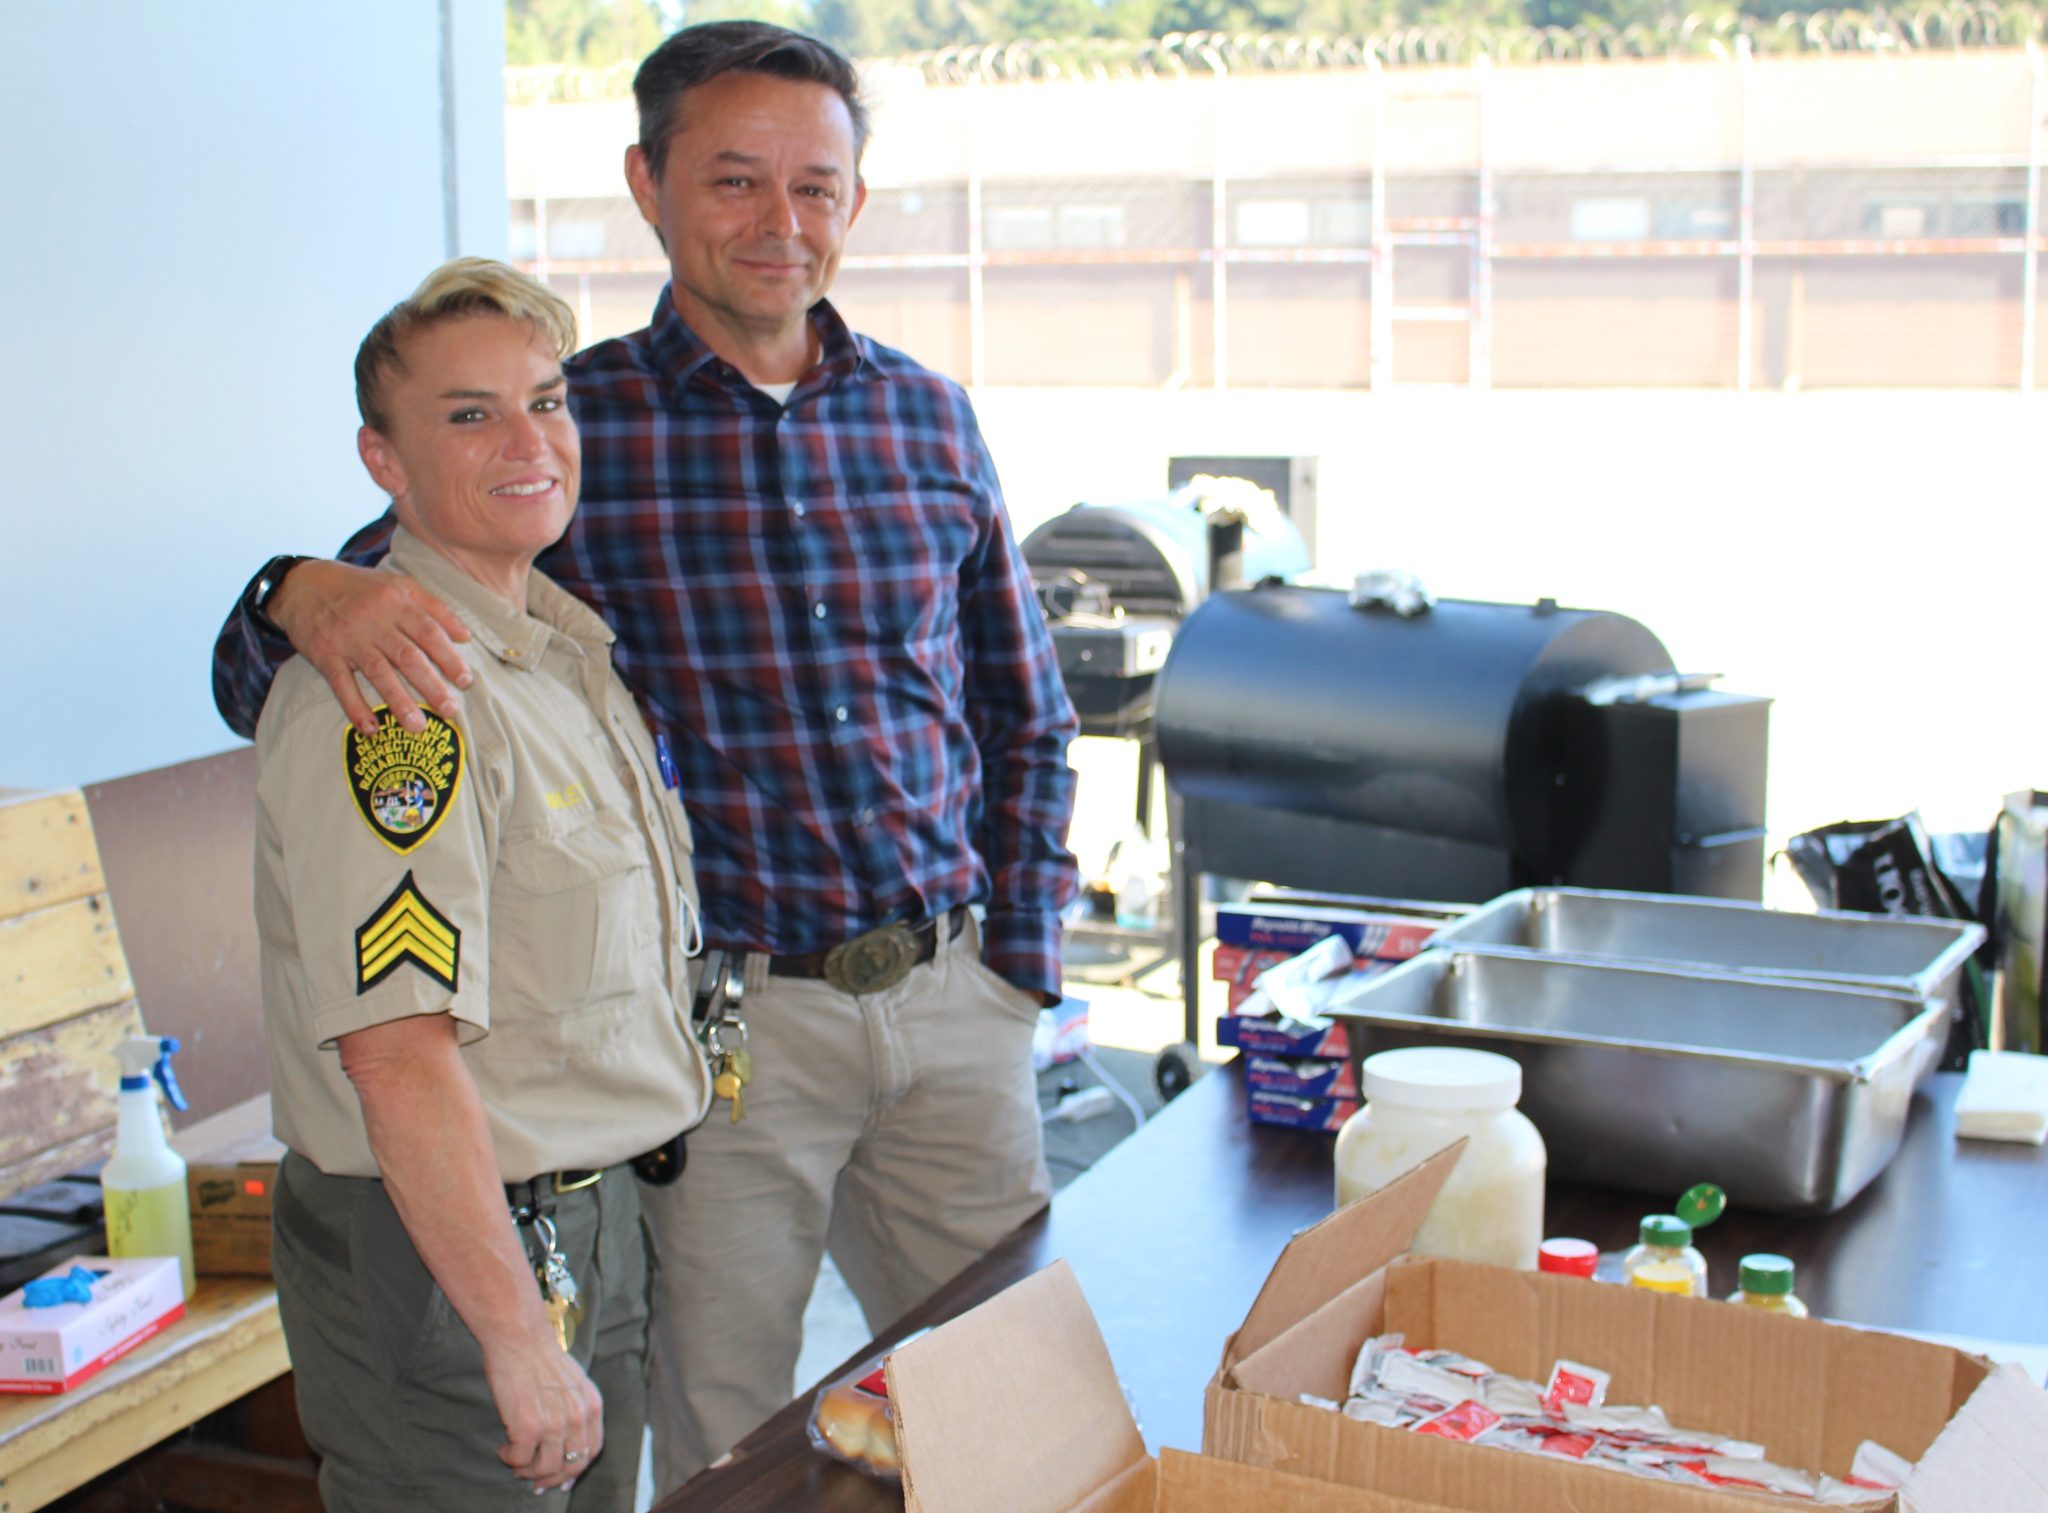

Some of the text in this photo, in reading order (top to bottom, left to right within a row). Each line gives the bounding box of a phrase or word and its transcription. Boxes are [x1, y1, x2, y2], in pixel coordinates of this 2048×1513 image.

[354, 739, 443, 776] CORRECTIONS
[436, 739, 455, 756] OF
[359, 752, 450, 791] REHABILITATION
[378, 771, 416, 791] EUREKA
